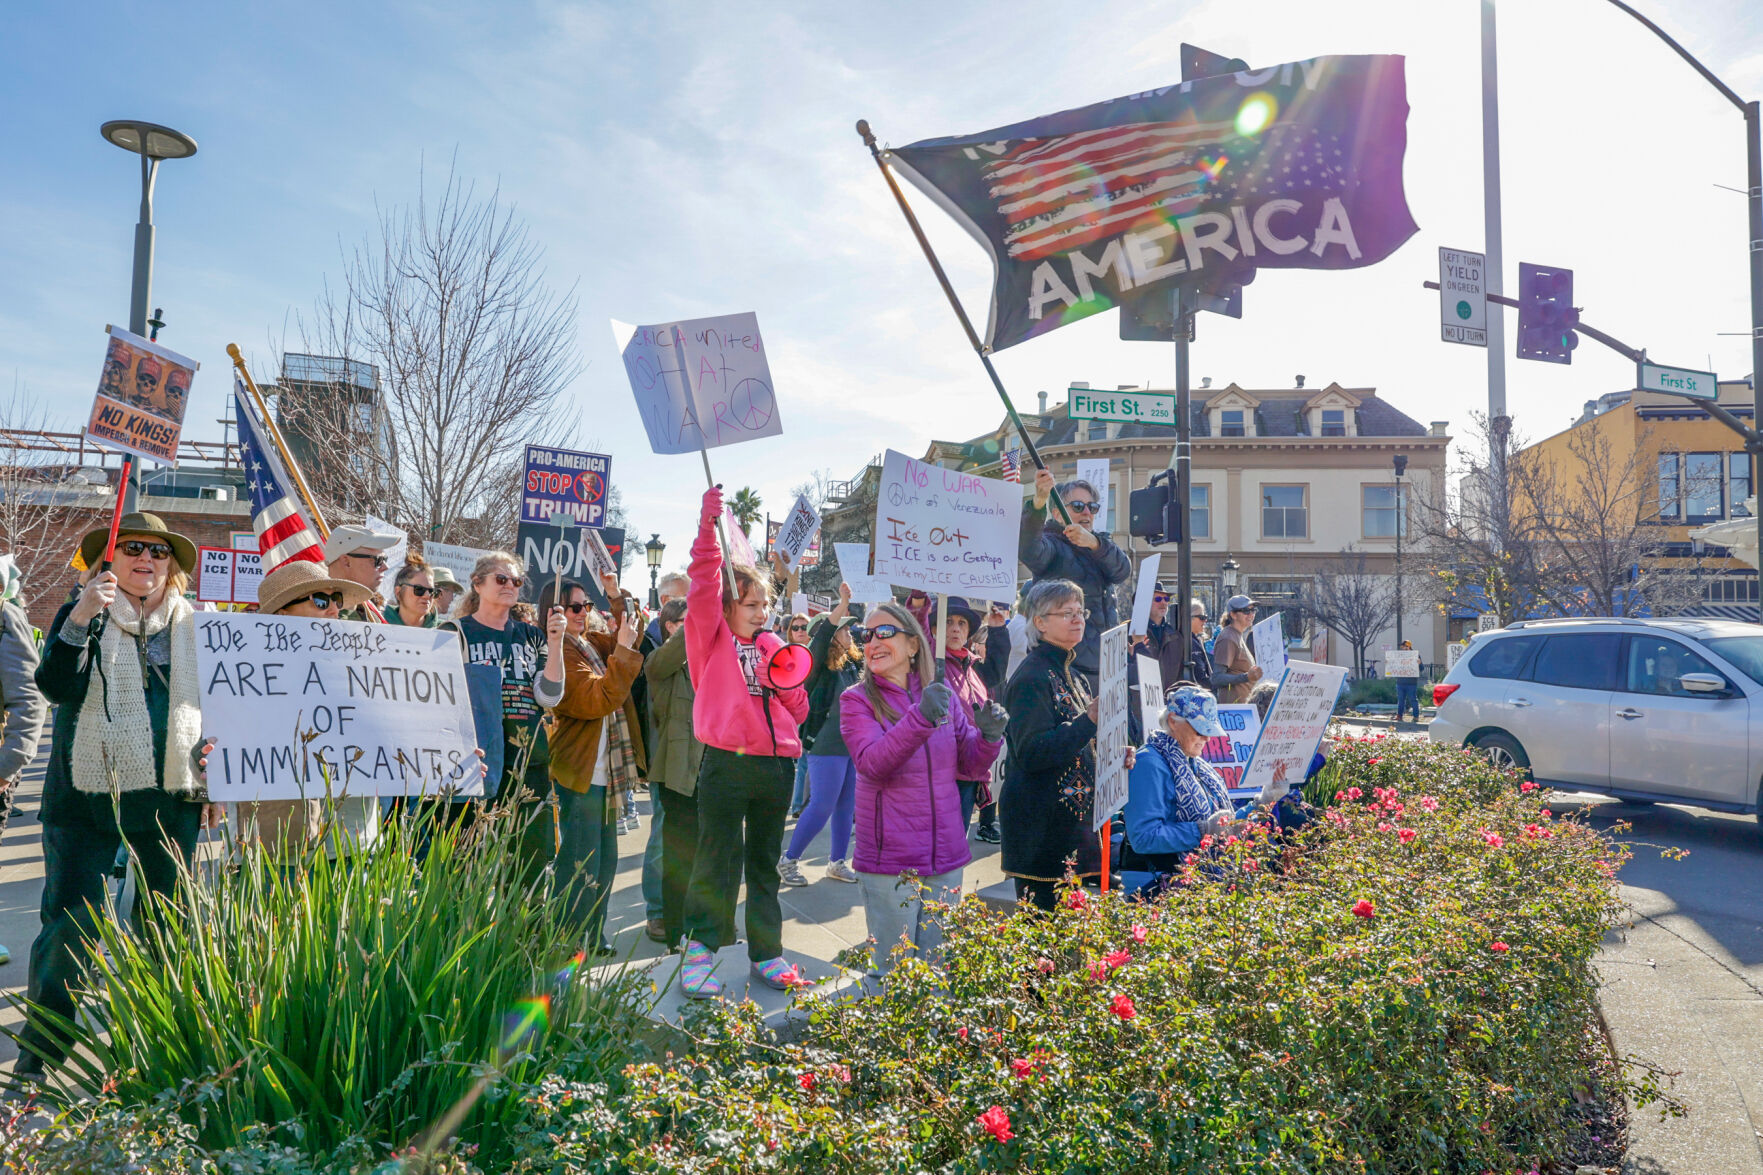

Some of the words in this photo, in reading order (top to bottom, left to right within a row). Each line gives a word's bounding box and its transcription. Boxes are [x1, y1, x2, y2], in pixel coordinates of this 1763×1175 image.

[1028, 197, 1363, 320] AMERICA
[1443, 252, 1459, 263] LEFT
[1463, 255, 1481, 267] TURN
[1447, 265, 1479, 281] YIELD
[1447, 280, 1456, 290] ON
[1458, 282, 1480, 294] GREEN
[1445, 327, 1455, 338] NO
[1456, 328, 1465, 342] U
[1466, 330, 1484, 342] TURN
[1661, 373, 1685, 389] First
[1686, 377, 1697, 391] St
[1075, 395, 1117, 414] First
[1121, 399, 1144, 416] St.
[1151, 409, 1169, 417] 2250
[94, 423, 131, 445] IMPEACH
[131, 439, 138, 448] &
[98, 404, 125, 427] NO
[125, 413, 178, 447] KINGS!
[529, 450, 606, 473] PRO-AMERICA
[527, 469, 573, 496] STOP
[943, 470, 987, 496] WAR
[525, 497, 603, 524] TRUMP
[784, 532, 801, 556] 1776
[891, 543, 921, 561] ICE
[207, 552, 227, 560] NO
[241, 554, 260, 564] NO
[204, 565, 228, 575] ICE
[237, 566, 263, 576] WAR
[200, 620, 248, 653] We
[208, 661, 288, 697] ARE
[302, 661, 326, 695] A
[346, 665, 456, 705] NATION
[312, 705, 356, 735] OF
[1219, 711, 1245, 731] the
[222, 745, 464, 784] IMMIGRANTS
